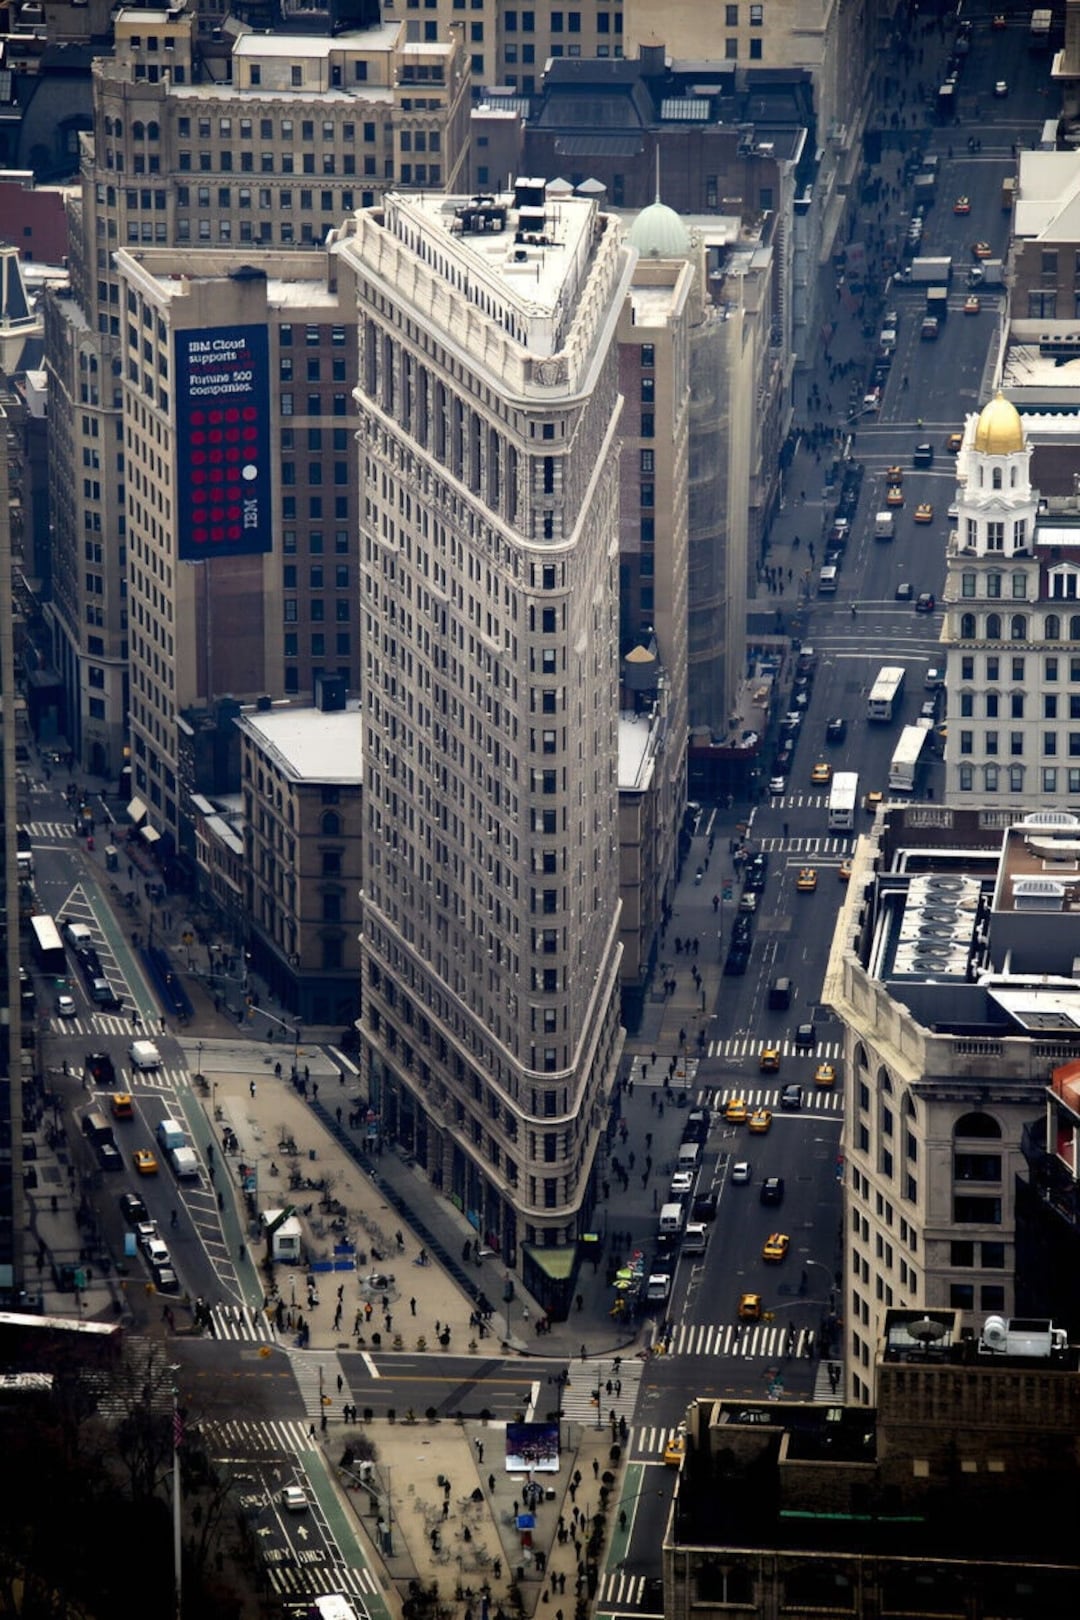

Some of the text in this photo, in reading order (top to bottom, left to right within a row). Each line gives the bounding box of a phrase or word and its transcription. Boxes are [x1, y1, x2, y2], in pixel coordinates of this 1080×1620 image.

[189, 338, 246, 352] IBM Cloud
[189, 352, 237, 365] supports
[190, 371, 253, 385] Fortune 500
[190, 382, 253, 395] companies.
[244, 499, 258, 528] IBM
